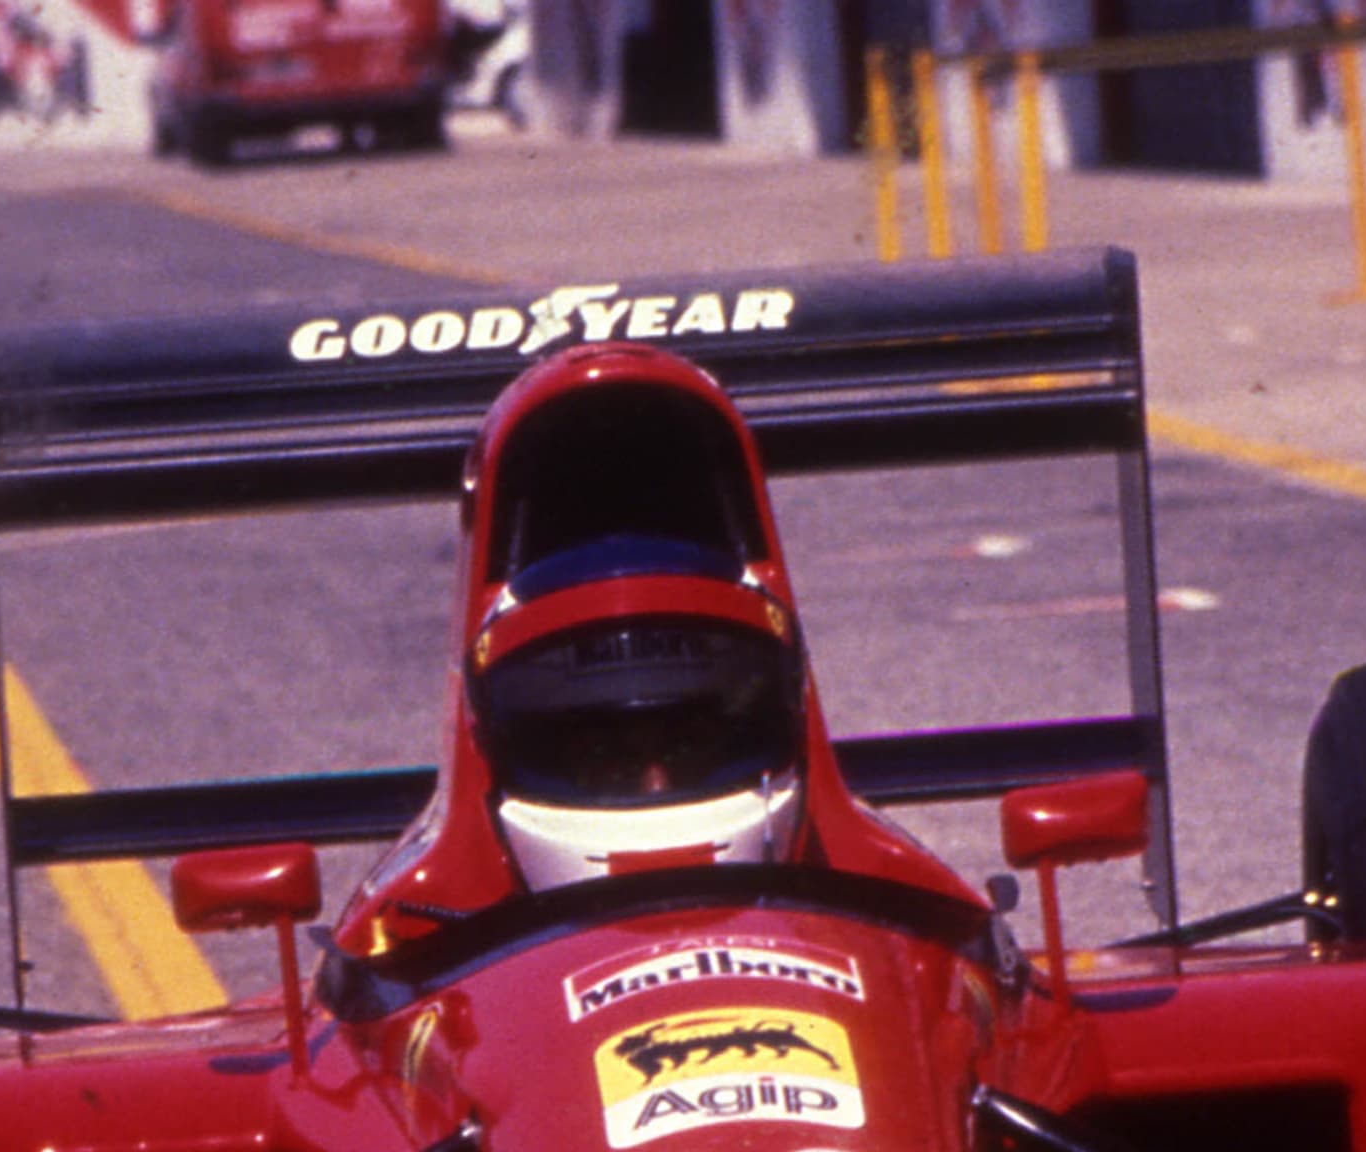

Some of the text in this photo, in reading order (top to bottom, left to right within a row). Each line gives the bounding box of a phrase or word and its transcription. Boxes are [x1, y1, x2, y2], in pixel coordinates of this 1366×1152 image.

[290, 283, 794, 361] GOODYEAR
[579, 950, 860, 1014] Marlboro
[632, 1076, 841, 1131] Agip
